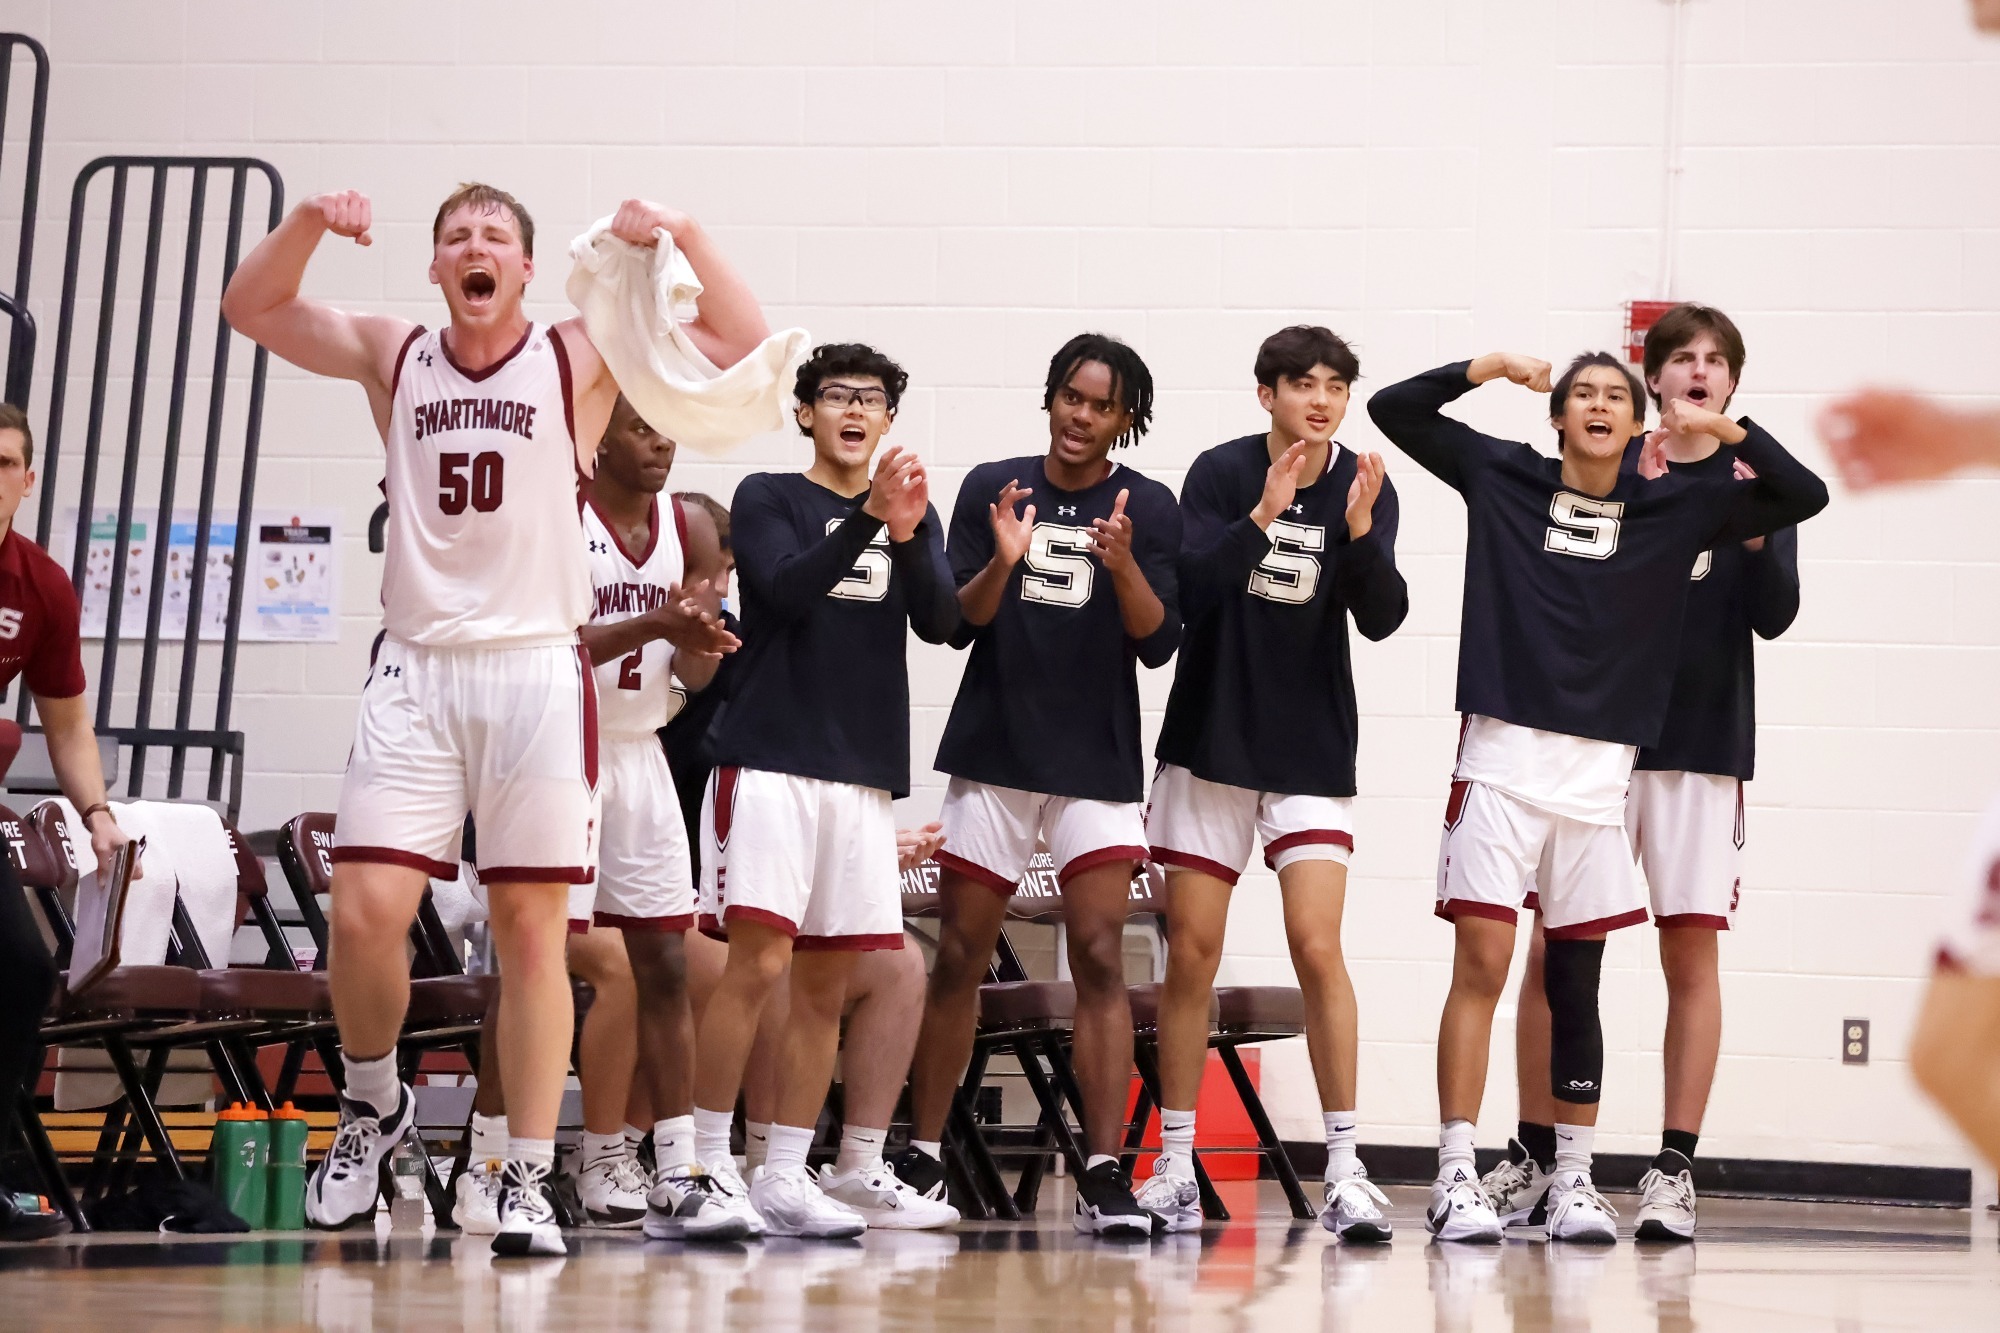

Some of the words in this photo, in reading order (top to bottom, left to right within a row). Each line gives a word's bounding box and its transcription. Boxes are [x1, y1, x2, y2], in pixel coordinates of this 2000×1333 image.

[414, 398, 537, 441] SWARTHMORE
[438, 450, 504, 516] 50
[1543, 490, 1625, 561] S
[1020, 521, 1099, 609] S
[1247, 517, 1326, 605] S
[590, 582, 671, 620] WARTHMO
[617, 645, 642, 691] 2
[1015, 869, 1062, 898] RNET
